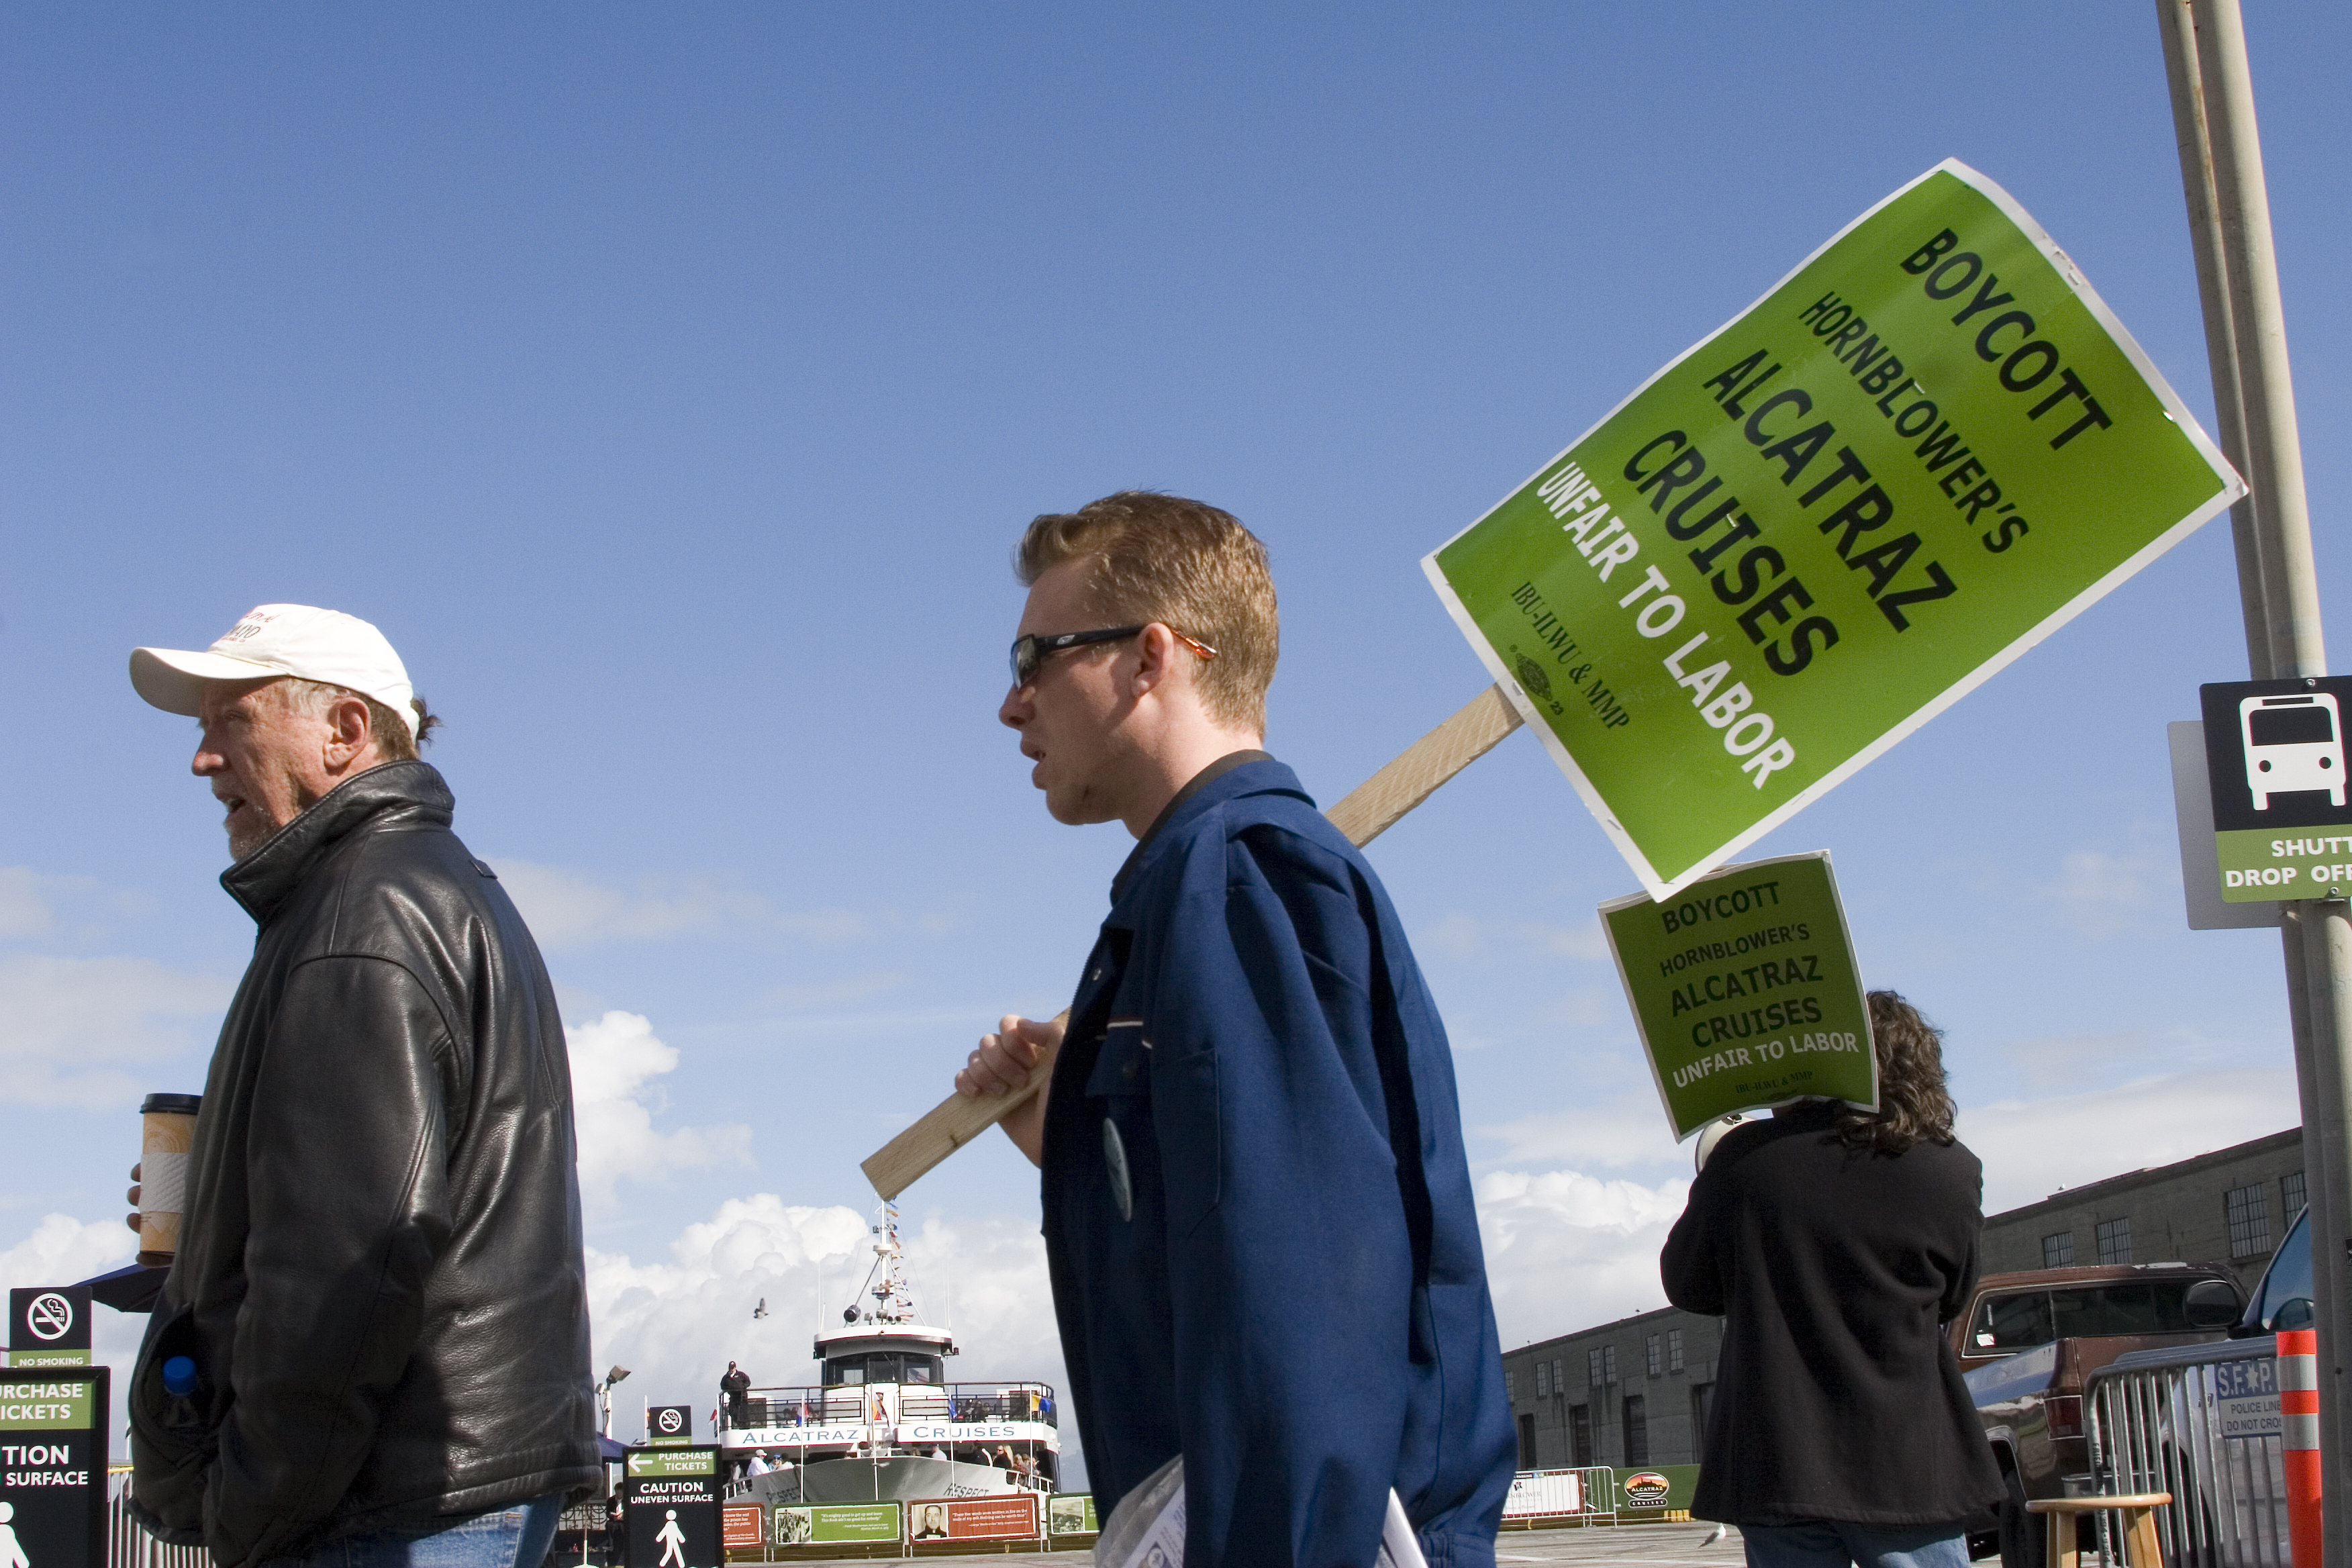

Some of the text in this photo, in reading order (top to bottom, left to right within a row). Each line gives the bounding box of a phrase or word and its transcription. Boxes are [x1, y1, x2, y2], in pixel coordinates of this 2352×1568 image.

[1900, 228, 2112, 450] BOYCOTT
[1798, 291, 2029, 555] HORNBLOWER'S
[1702, 348, 1958, 633] ALCATRAZ
[1622, 430, 1840, 677] CRUISES
[1536, 461, 1796, 790] UNFAIR TO LABOR
[1512, 581, 1581, 664] IBU-ILWU
[1569, 663, 1592, 685] &
[1581, 679, 1630, 729] MMP
[2271, 836, 2352, 857] SHUTT
[2225, 867, 2297, 887] DROP
[1661, 881, 1779, 934] BOYCOTT
[1659, 923, 1810, 978] HORNBLOWER'S
[1671, 954, 1824, 1018] ALCATRAZ
[1691, 997, 1822, 1048] CRUISES
[1673, 1032, 1859, 1088] UNFAIR TO LABOR
[19, 1357, 83, 1367] NO SMOKING
[0, 1383, 83, 1399] RCHASE
[0, 1404, 71, 1420] ICKETS
[2231, 1400, 2281, 1414] POLICE LINE
[914, 1426, 1015, 1438] CRUISES
[2226, 1418, 2282, 1431] DO NOT CRO
[742, 1429, 859, 1444] ALCATRAZ
[0, 1445, 69, 1465] TION
[658, 1451, 714, 1461] PURCHASE
[665, 1462, 707, 1471] TICKETS
[5, 1471, 89, 1487] SURFACE
[640, 1481, 703, 1494] CAUTION
[631, 1494, 714, 1504] UNEVEN SURFACE
[944, 1483, 989, 1498] RESPECT
